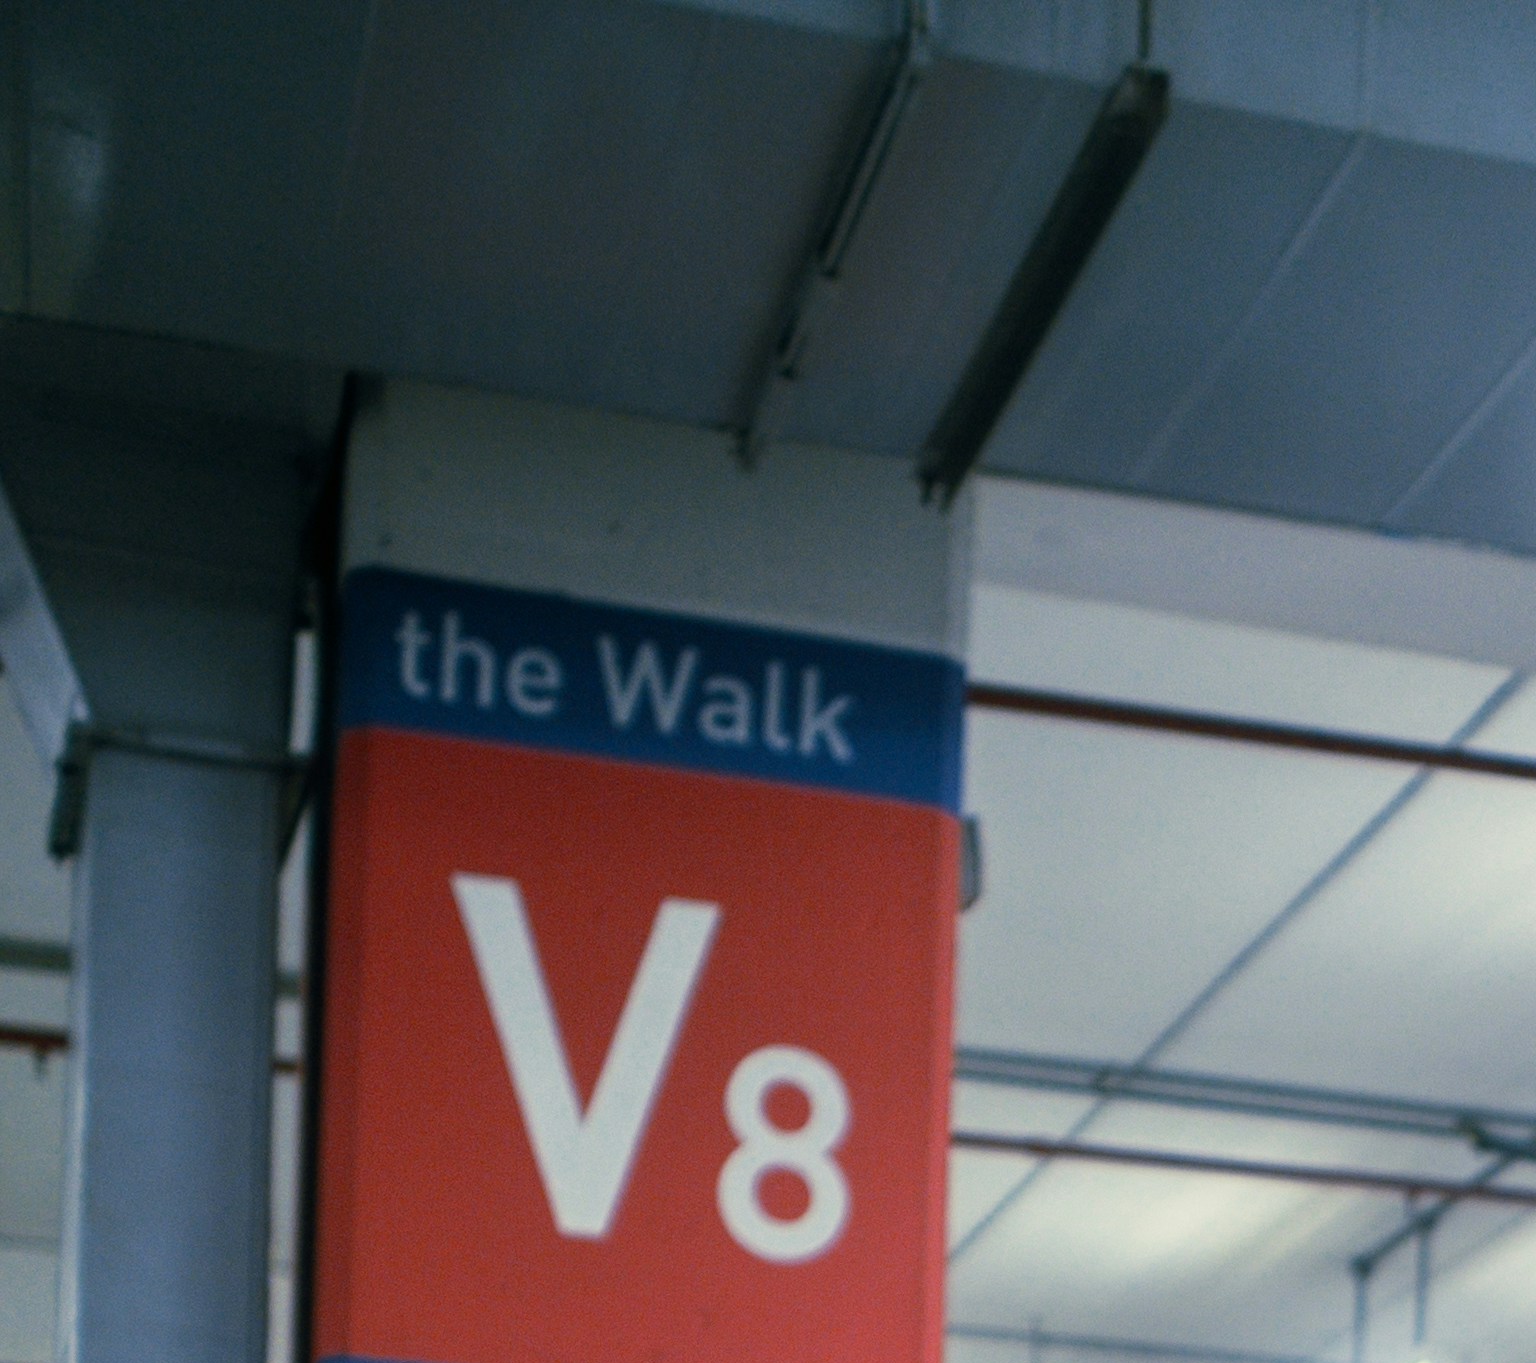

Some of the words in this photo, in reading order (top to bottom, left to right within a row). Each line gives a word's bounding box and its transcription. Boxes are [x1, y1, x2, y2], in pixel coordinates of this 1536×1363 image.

[396, 608, 565, 717] the
[598, 635, 856, 765] Walk
[450, 870, 853, 1264] V8
